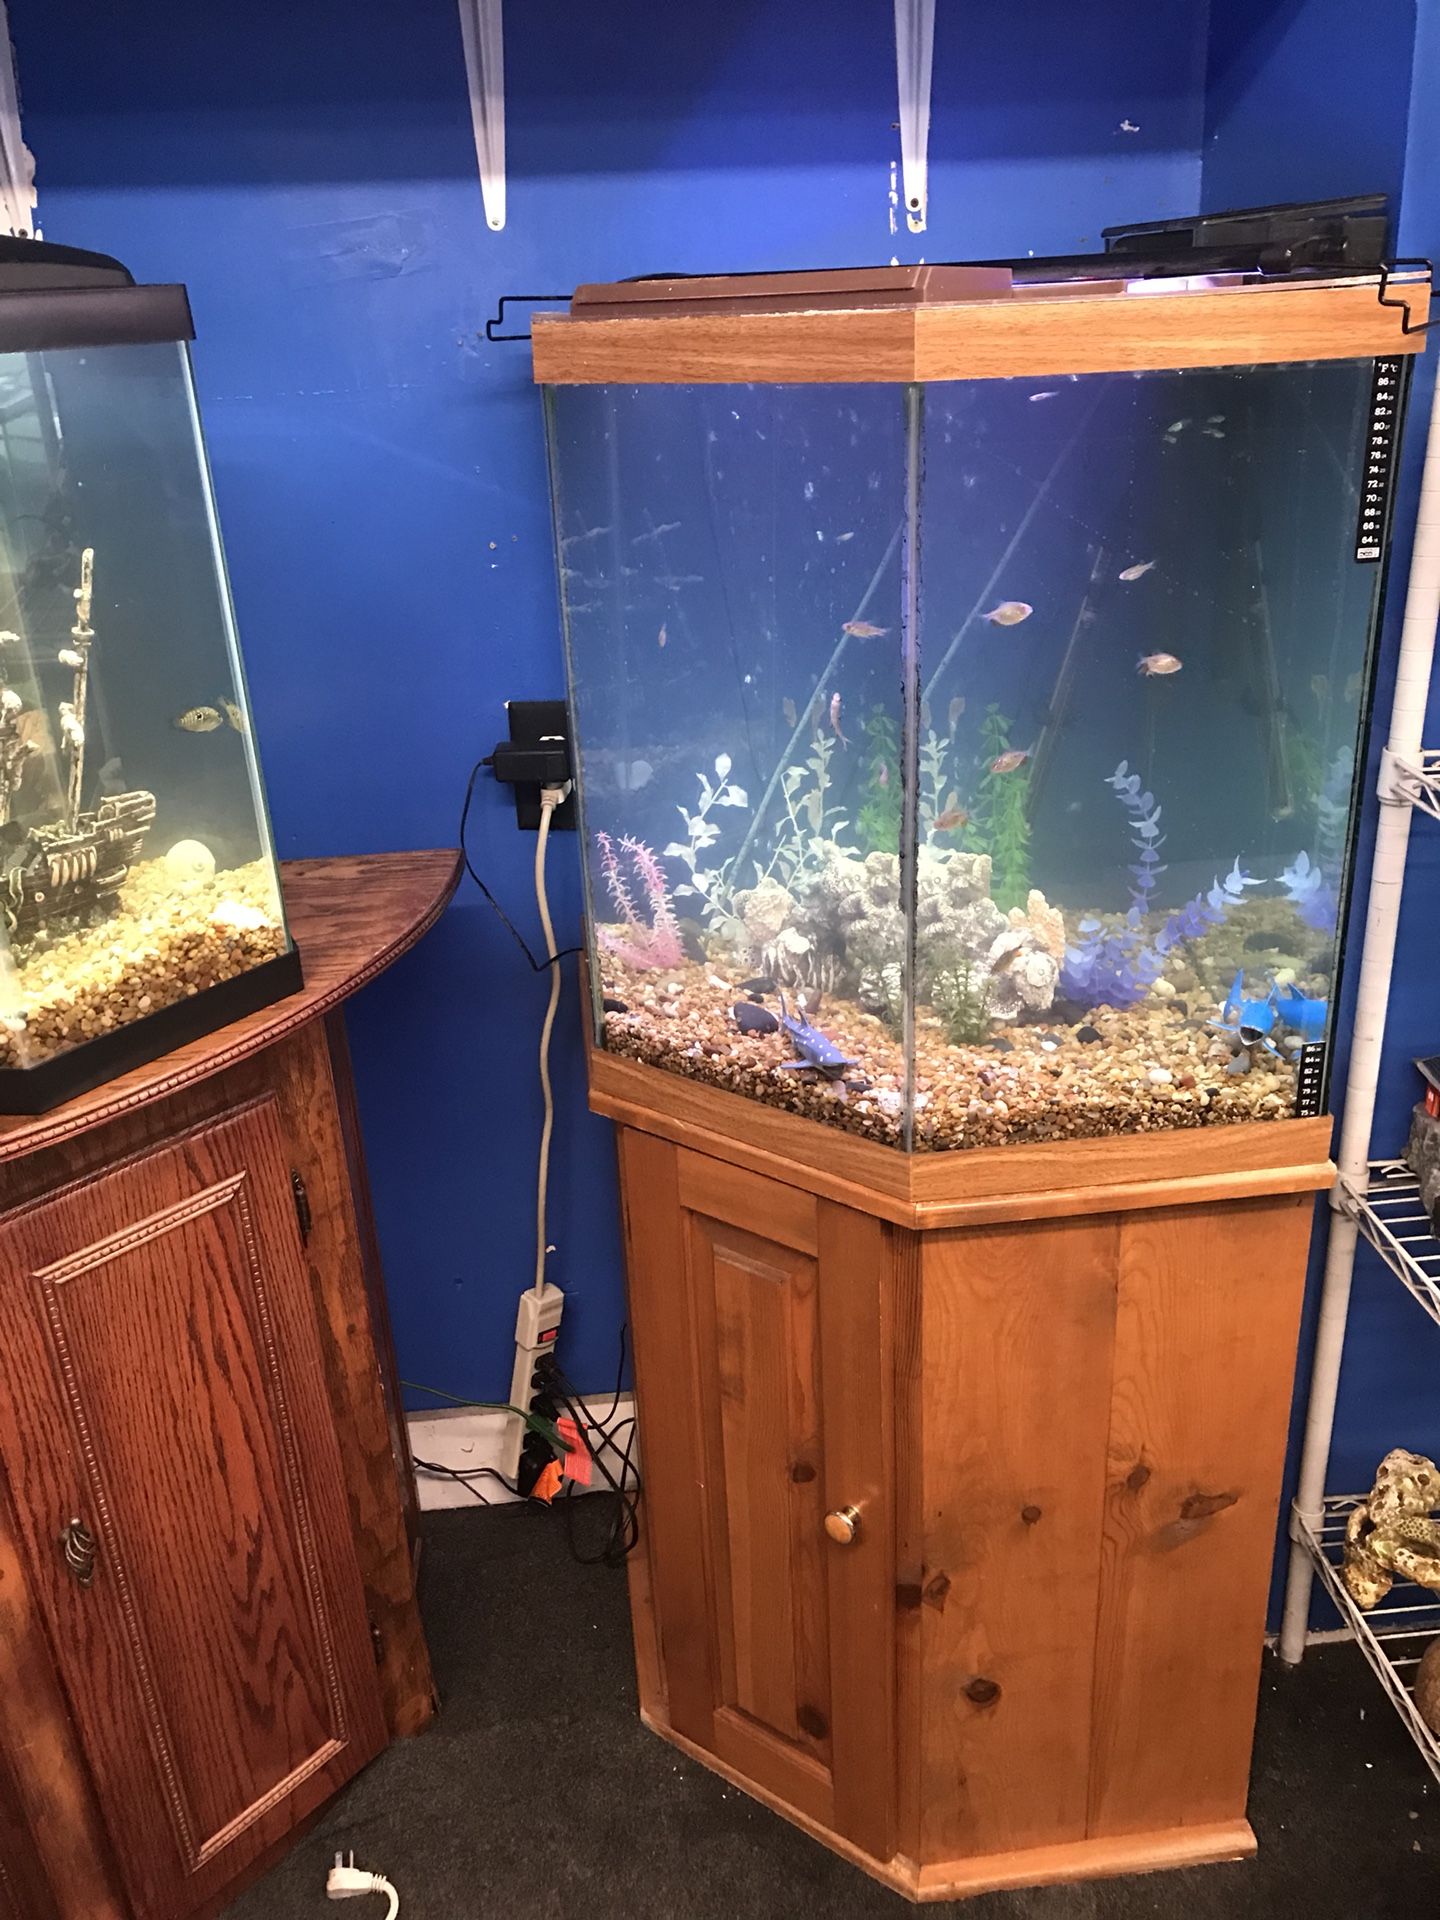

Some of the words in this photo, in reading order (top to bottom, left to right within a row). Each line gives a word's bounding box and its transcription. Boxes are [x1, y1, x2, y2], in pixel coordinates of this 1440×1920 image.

[1377, 377, 1389, 386] 86
[1376, 392, 1388, 401] 84
[1374, 407, 1386, 416] 82
[1373, 421, 1385, 431] 80
[1372, 436, 1383, 445] 78
[1370, 451, 1381, 460] 76
[1369, 465, 1379, 474] 74
[1367, 479, 1378, 489] 72
[1366, 494, 1377, 503] 70
[1364, 508, 1376, 517] 68
[1362, 522, 1374, 531] 66
[1361, 535, 1373, 544] 64
